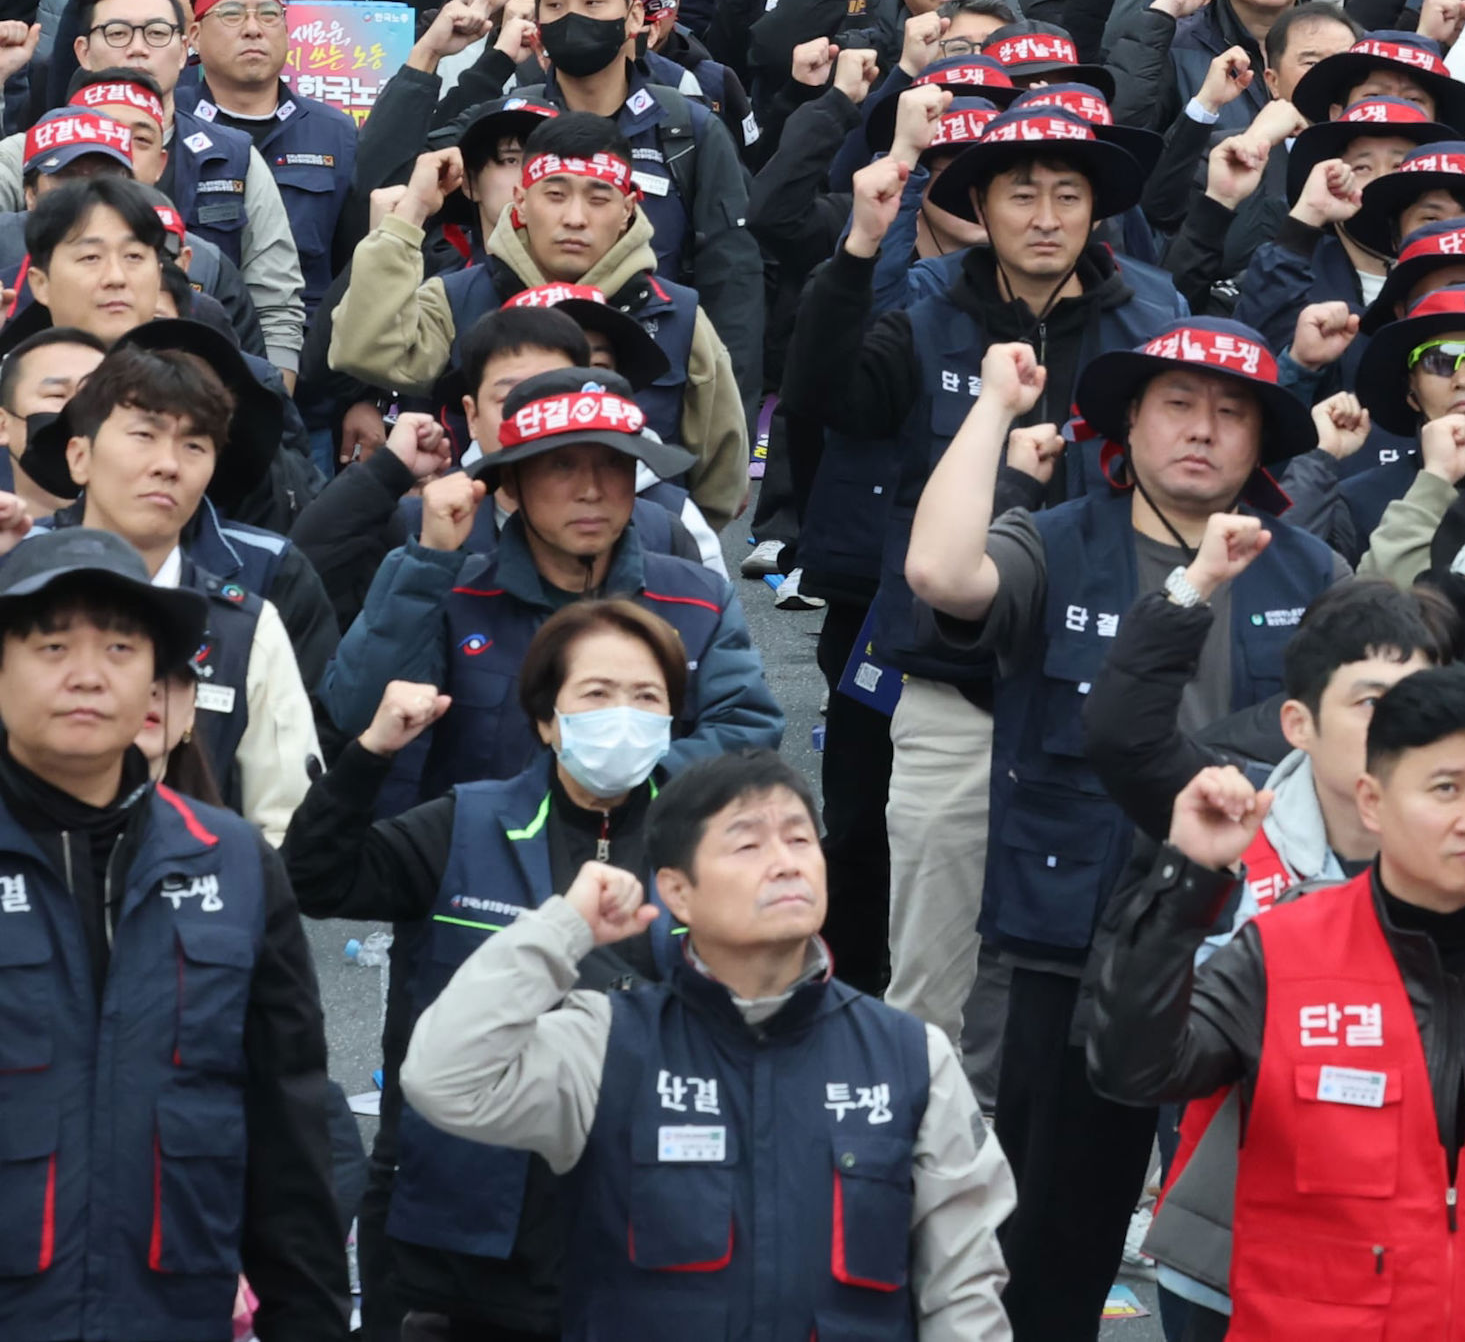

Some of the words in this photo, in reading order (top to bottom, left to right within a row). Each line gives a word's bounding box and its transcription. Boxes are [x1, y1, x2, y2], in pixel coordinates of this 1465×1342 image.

[350, 44, 386, 70] 노동
[1064, 604, 1120, 638] 단결
[160, 874, 224, 912] 투쟁
[1299, 1002, 1384, 1047] 단결
[824, 1081, 892, 1124] 투쟁
